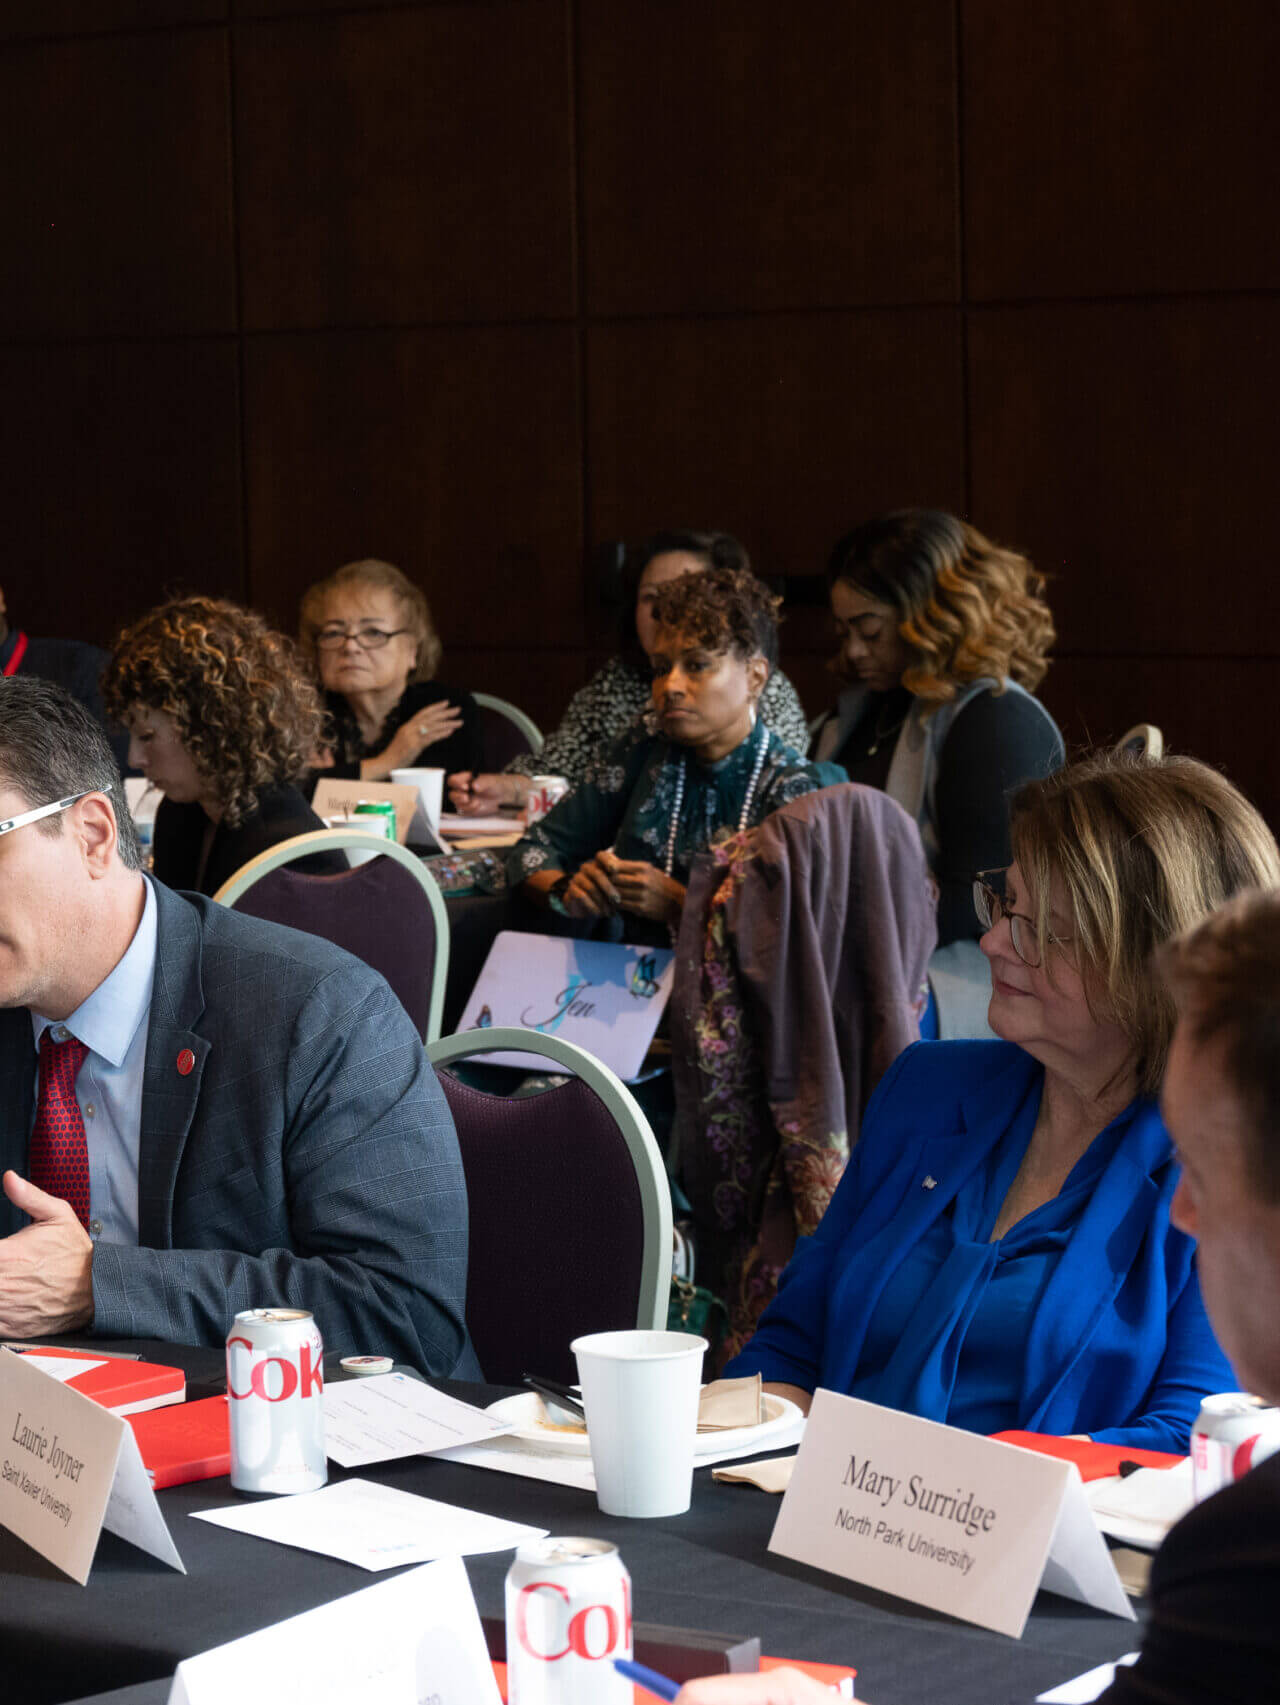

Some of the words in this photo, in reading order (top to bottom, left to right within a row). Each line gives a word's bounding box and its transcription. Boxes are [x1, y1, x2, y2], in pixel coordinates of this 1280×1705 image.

[521, 982, 596, 1028] Jen
[12, 1412, 48, 1459] Laurie
[47, 1435, 85, 1482] Joyner
[1, 1460, 21, 1487] Saint
[18, 1471, 42, 1500] Xavier
[39, 1486, 73, 1529] University
[841, 1454, 902, 1507] Mary
[903, 1474, 997, 1536] Surridge
[835, 1508, 872, 1537] North
[873, 1520, 906, 1550] Park
[907, 1532, 975, 1576] University
